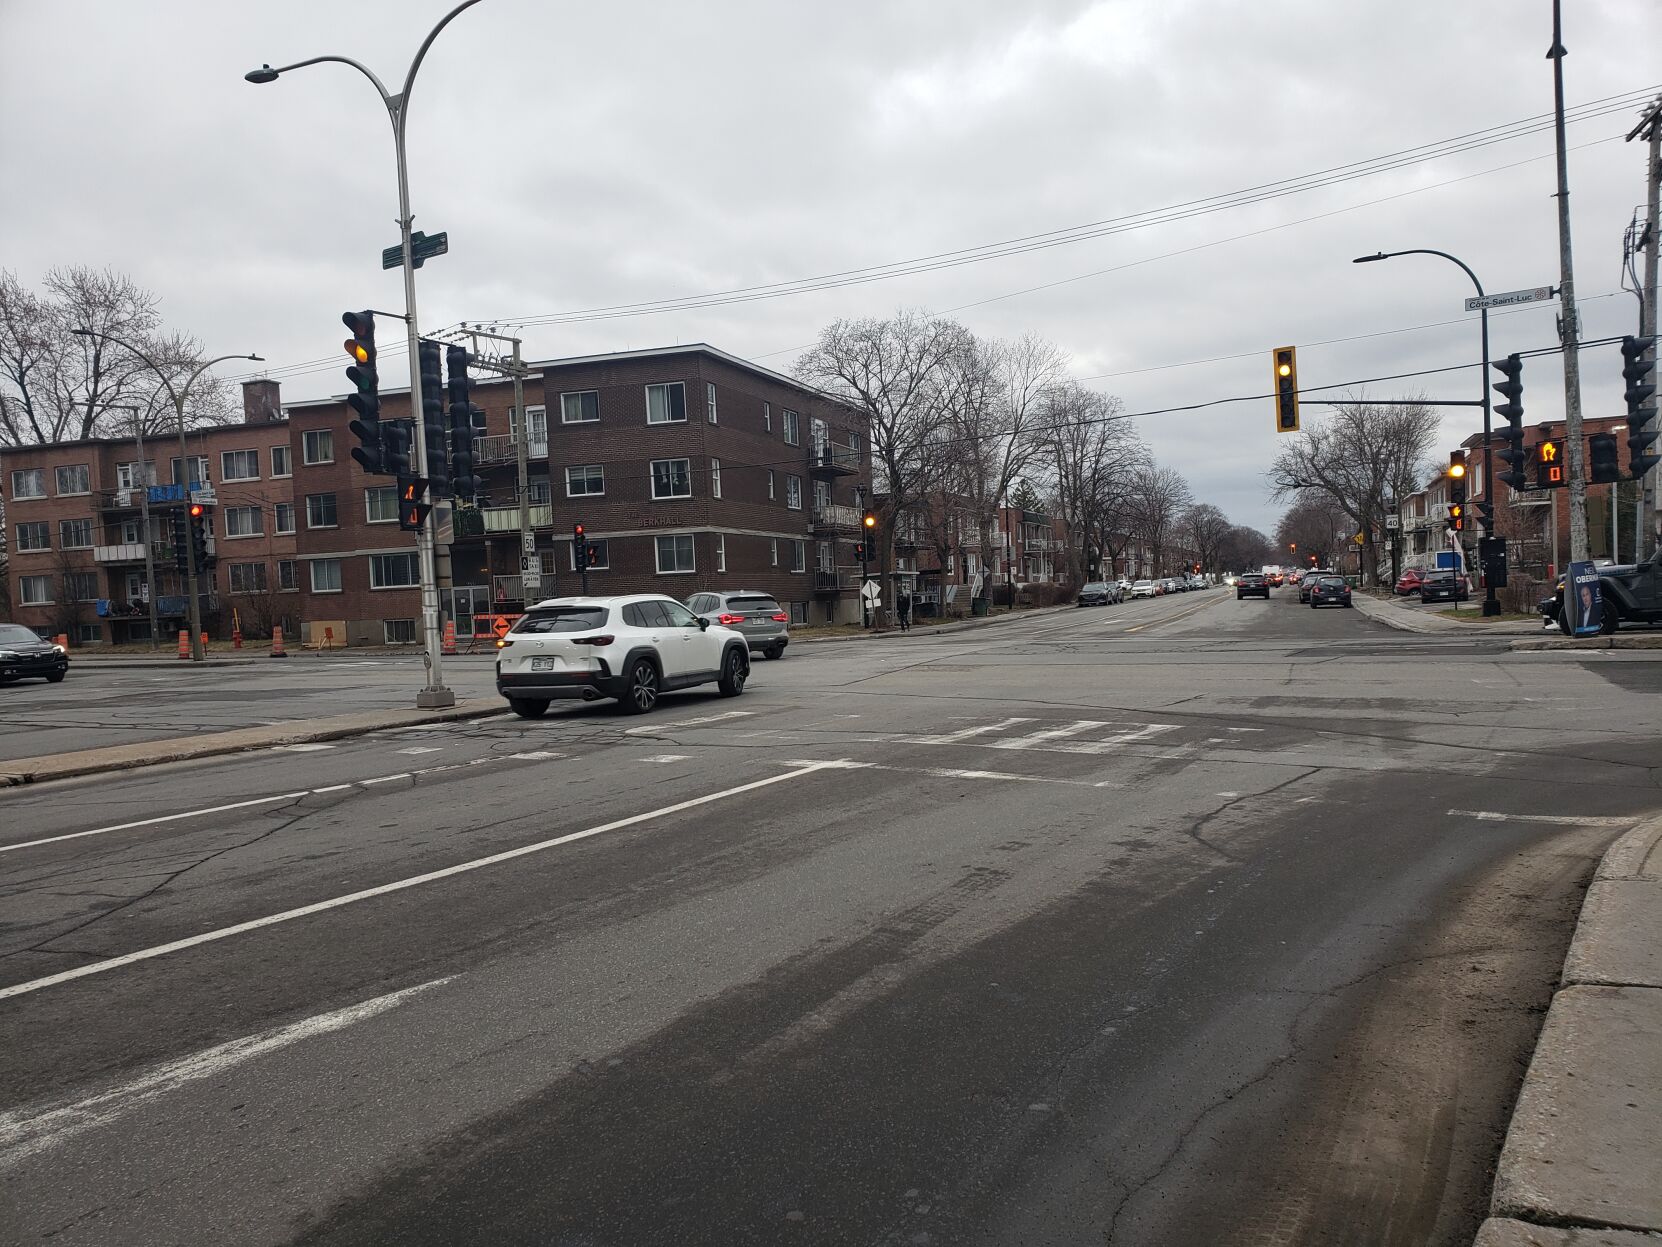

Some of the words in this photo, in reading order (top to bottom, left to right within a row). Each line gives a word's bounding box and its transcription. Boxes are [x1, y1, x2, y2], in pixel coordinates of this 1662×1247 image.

[1469, 295, 1533, 309] Côte-Saint-Luc
[1387, 519, 1398, 527] 40
[526, 539, 534, 548] 50
